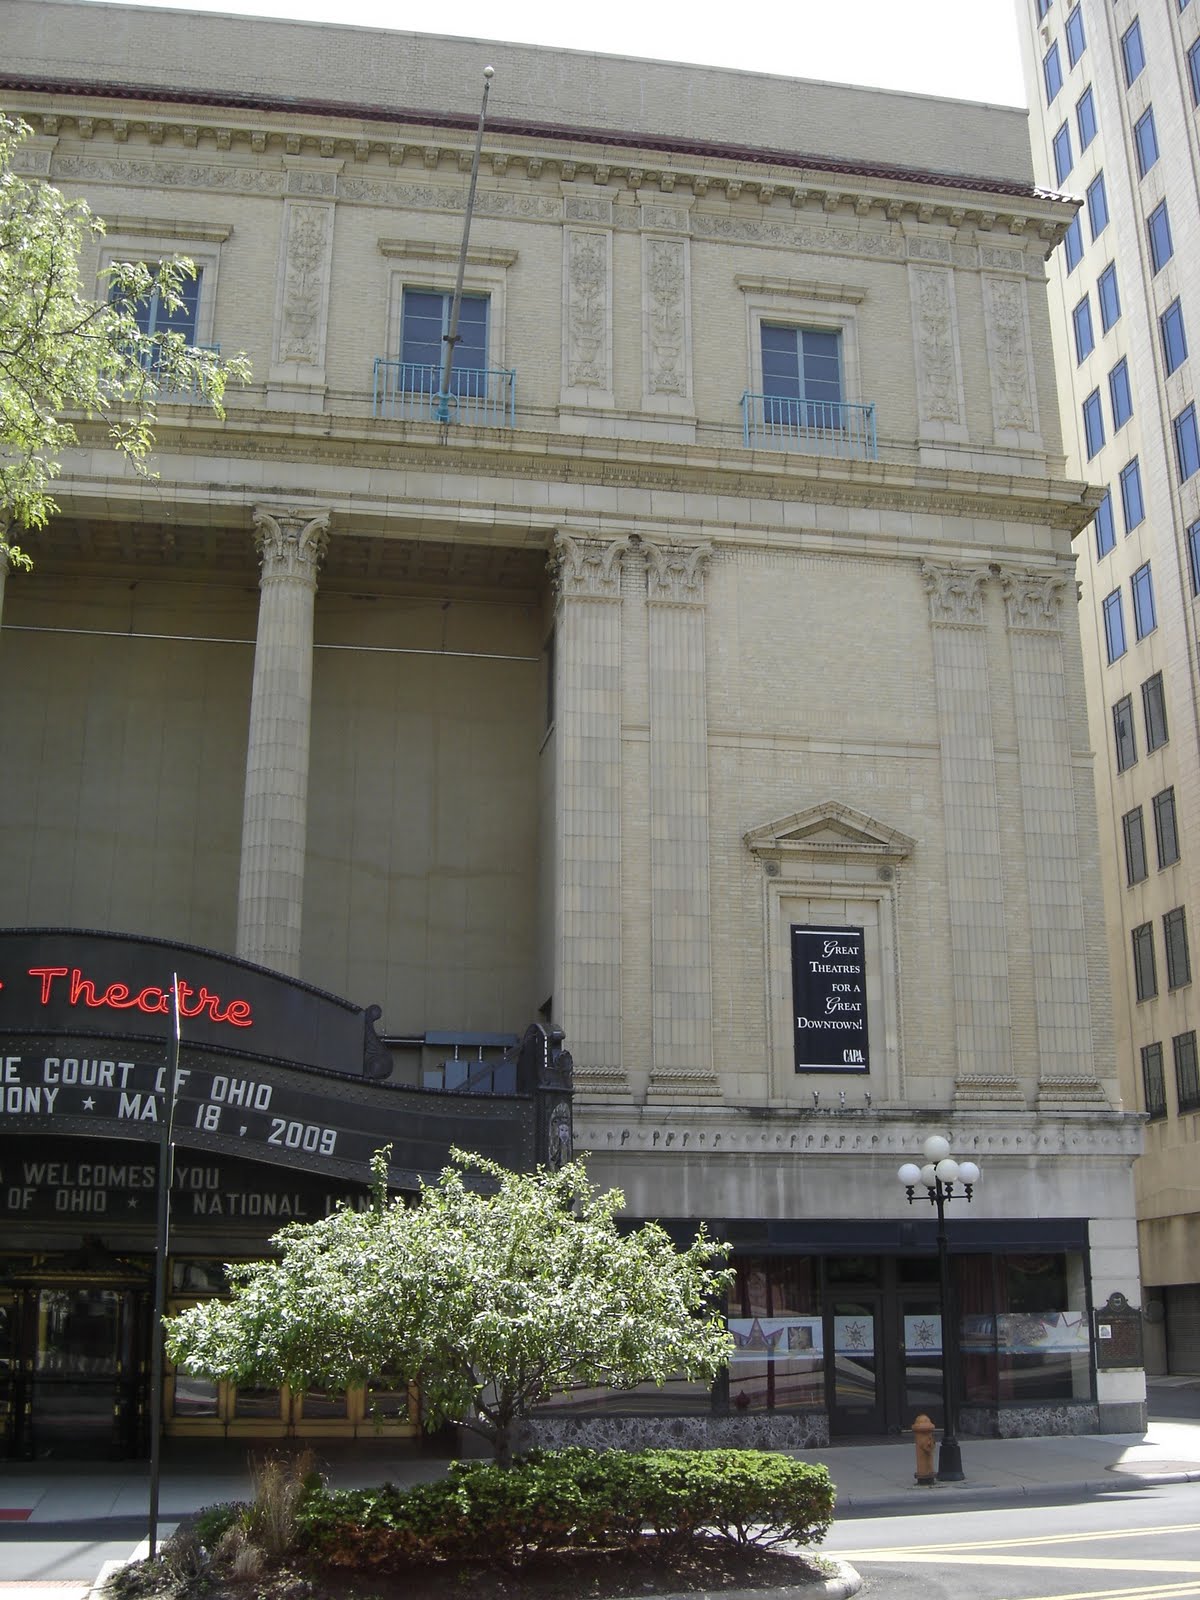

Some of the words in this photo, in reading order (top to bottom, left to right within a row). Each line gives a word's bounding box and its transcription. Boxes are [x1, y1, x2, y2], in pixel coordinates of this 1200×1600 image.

[28, 967, 253, 1027] Theatre
[843, 1049, 865, 1063] CAPA
[0, 1056, 22, 1083] E
[44, 1057, 136, 1089] COURT
[210, 1076, 273, 1111] OHIO
[118, 1092, 178, 1123] MA
[267, 1118, 338, 1156] 2009
[24, 1163, 156, 1188] WELCOMES
[177, 1167, 220, 1190] YOU
[8, 1187, 37, 1210] OF
[56, 1190, 107, 1212] OHIO
[193, 1192, 308, 1217] NATIONAL
